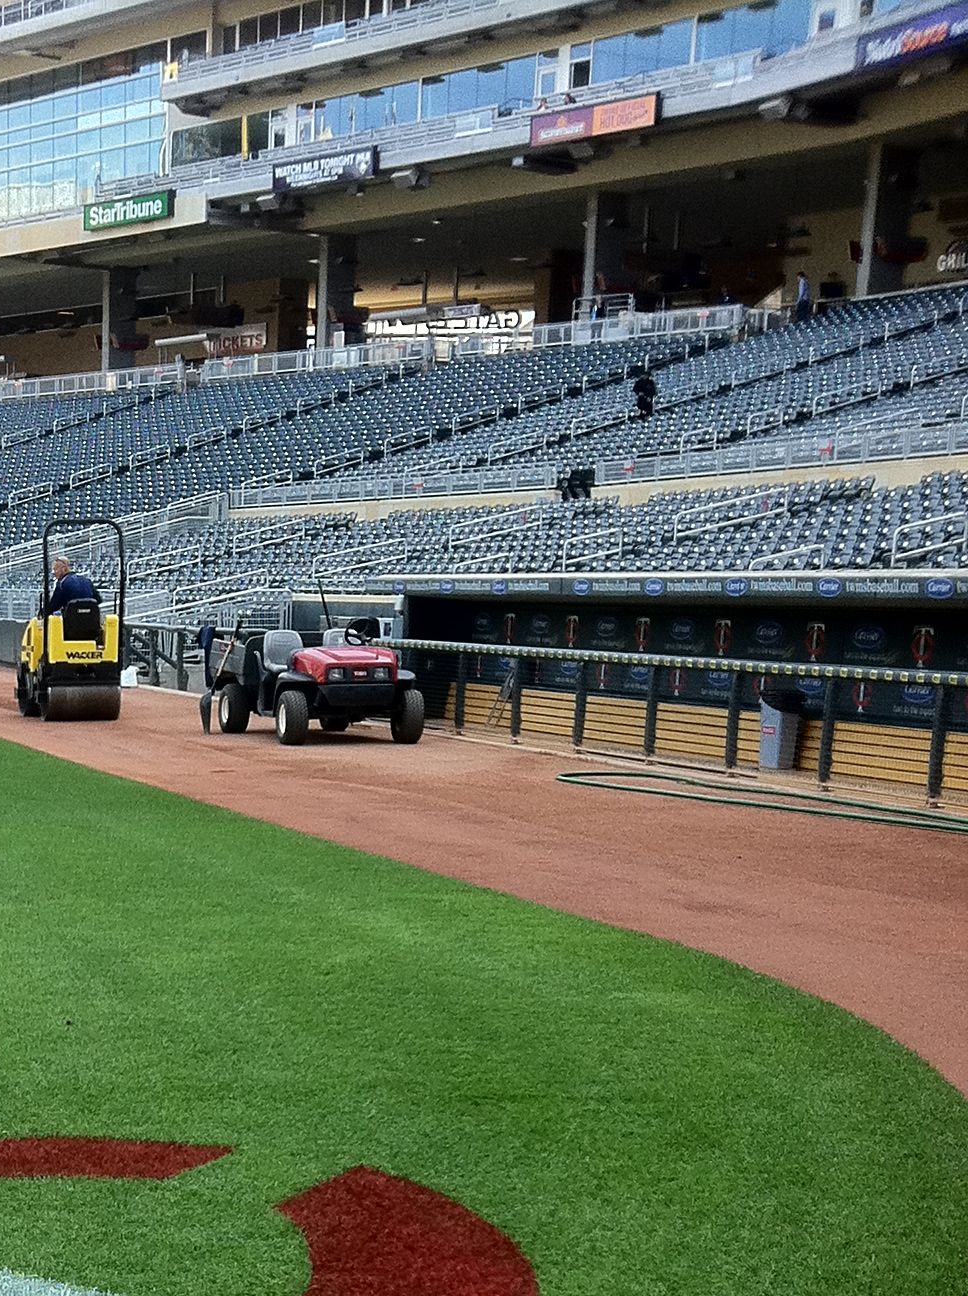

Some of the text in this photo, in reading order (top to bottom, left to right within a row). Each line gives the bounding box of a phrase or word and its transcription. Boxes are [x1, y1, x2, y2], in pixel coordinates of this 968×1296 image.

[89, 199, 163, 226] StarTribune
[751, 578, 813, 592] twinsbaseball.com
[846, 577, 919, 593] twinsbaseball.com
[66, 651, 103, 659] WACKER
